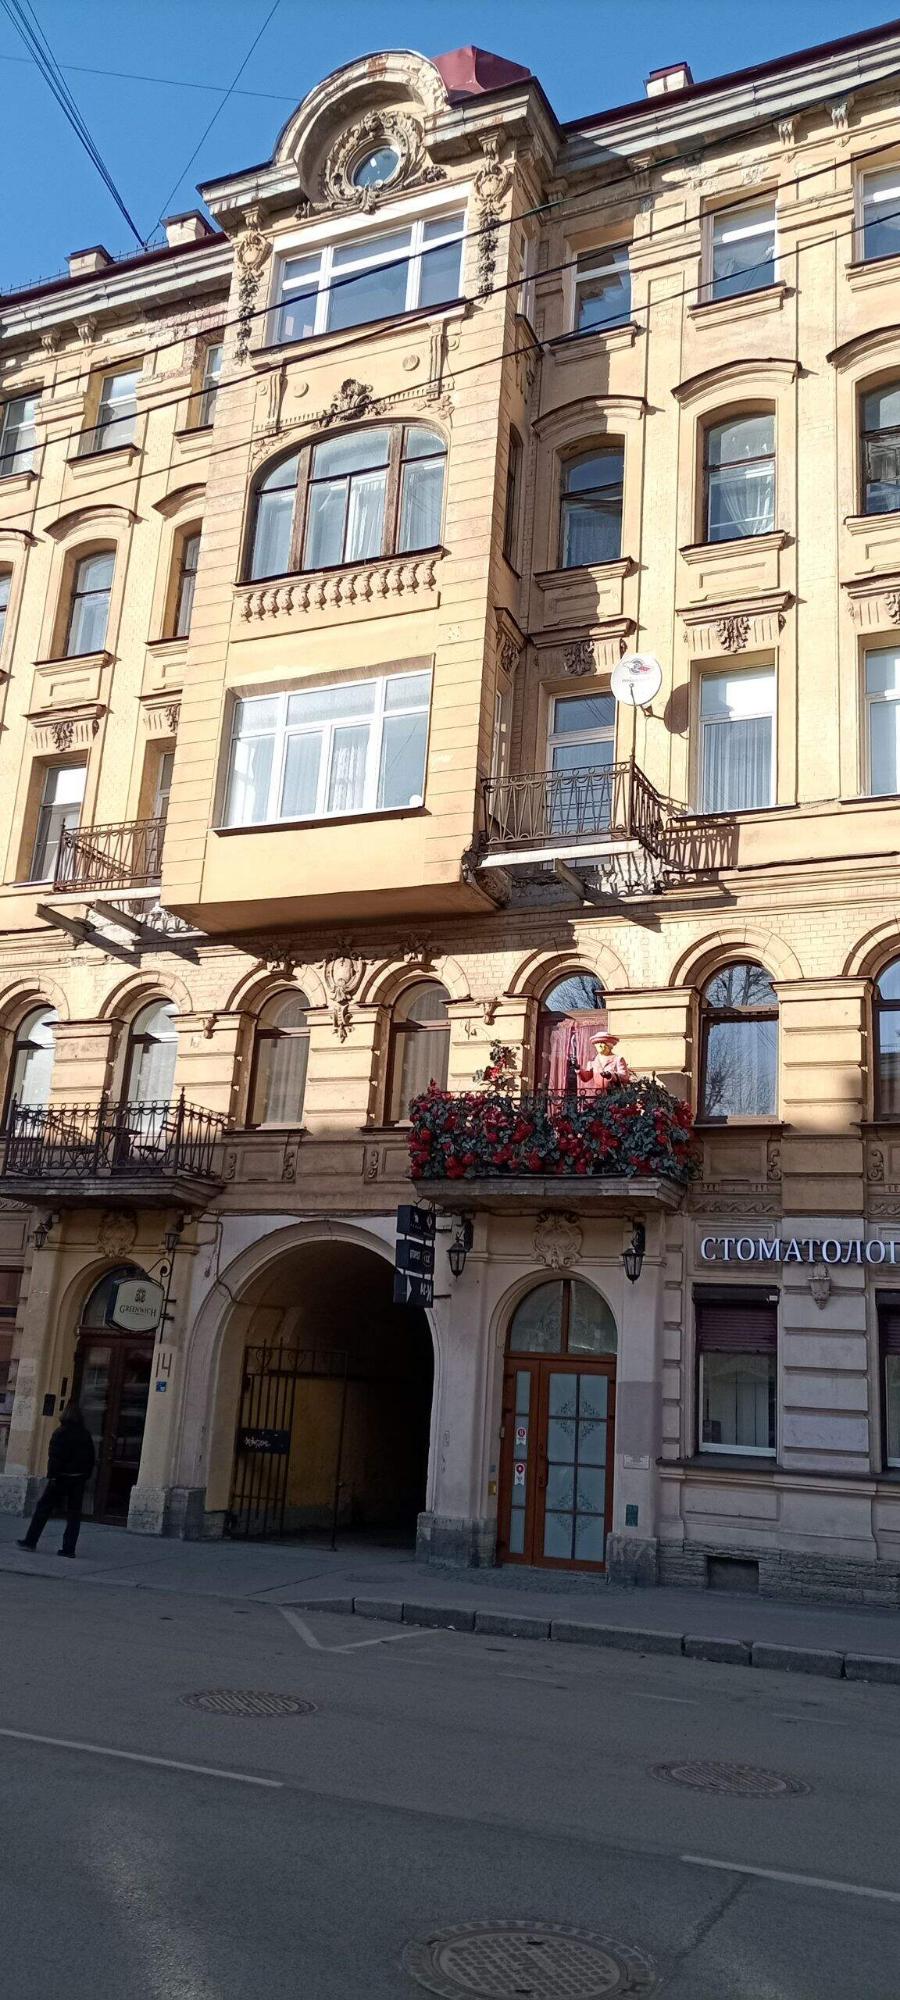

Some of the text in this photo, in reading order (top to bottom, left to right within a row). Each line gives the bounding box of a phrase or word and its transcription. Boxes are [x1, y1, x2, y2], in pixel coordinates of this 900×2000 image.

[701, 1237, 900, 1264] СТОМАТОЛОГ
[119, 1304, 157, 1318] GREENWICH
[155, 1353, 172, 1377] 14
